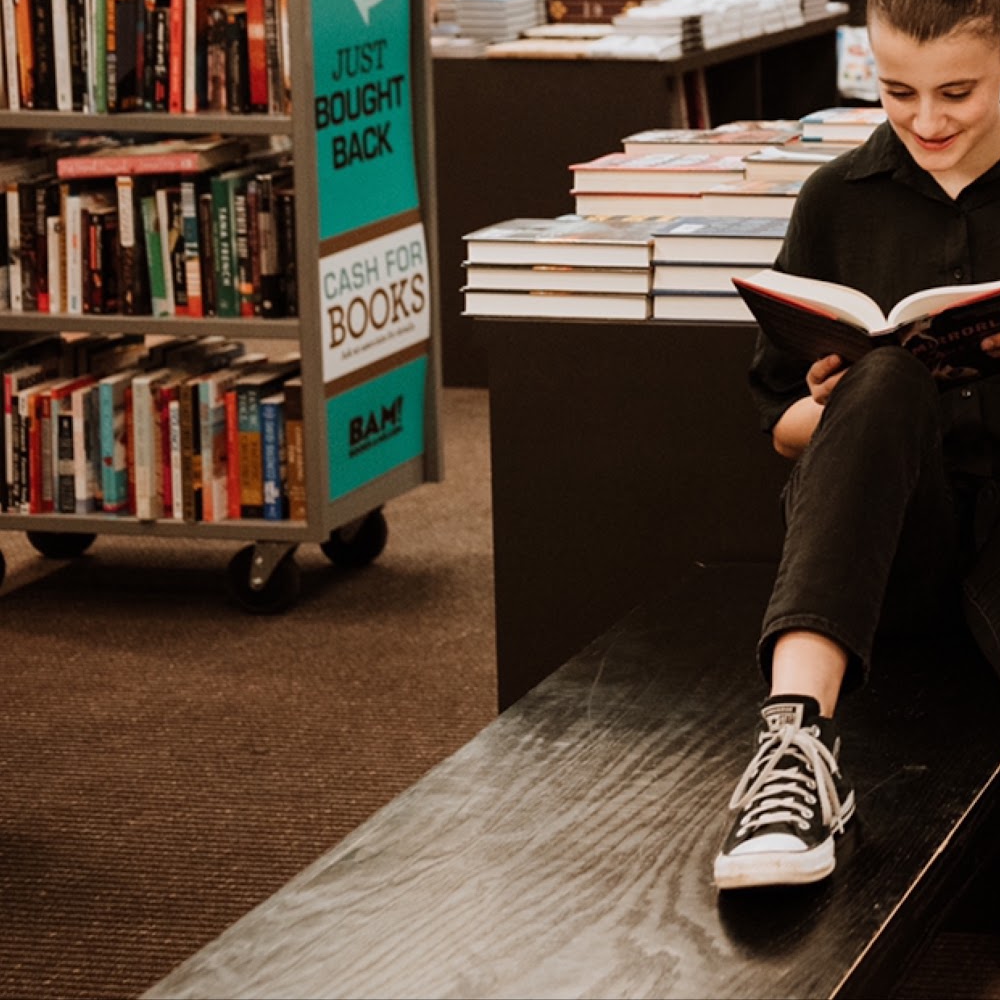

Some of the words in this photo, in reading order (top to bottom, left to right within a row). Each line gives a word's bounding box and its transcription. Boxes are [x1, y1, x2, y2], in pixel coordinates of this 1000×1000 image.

[332, 39, 388, 81] JUST
[315, 74, 405, 131] BOUGHT
[333, 121, 394, 170] BACK
[324, 256, 380, 300] CASH
[385, 241, 423, 277] FOR
[328, 273, 425, 349] BOOKS
[348, 394, 404, 447] BAM!
